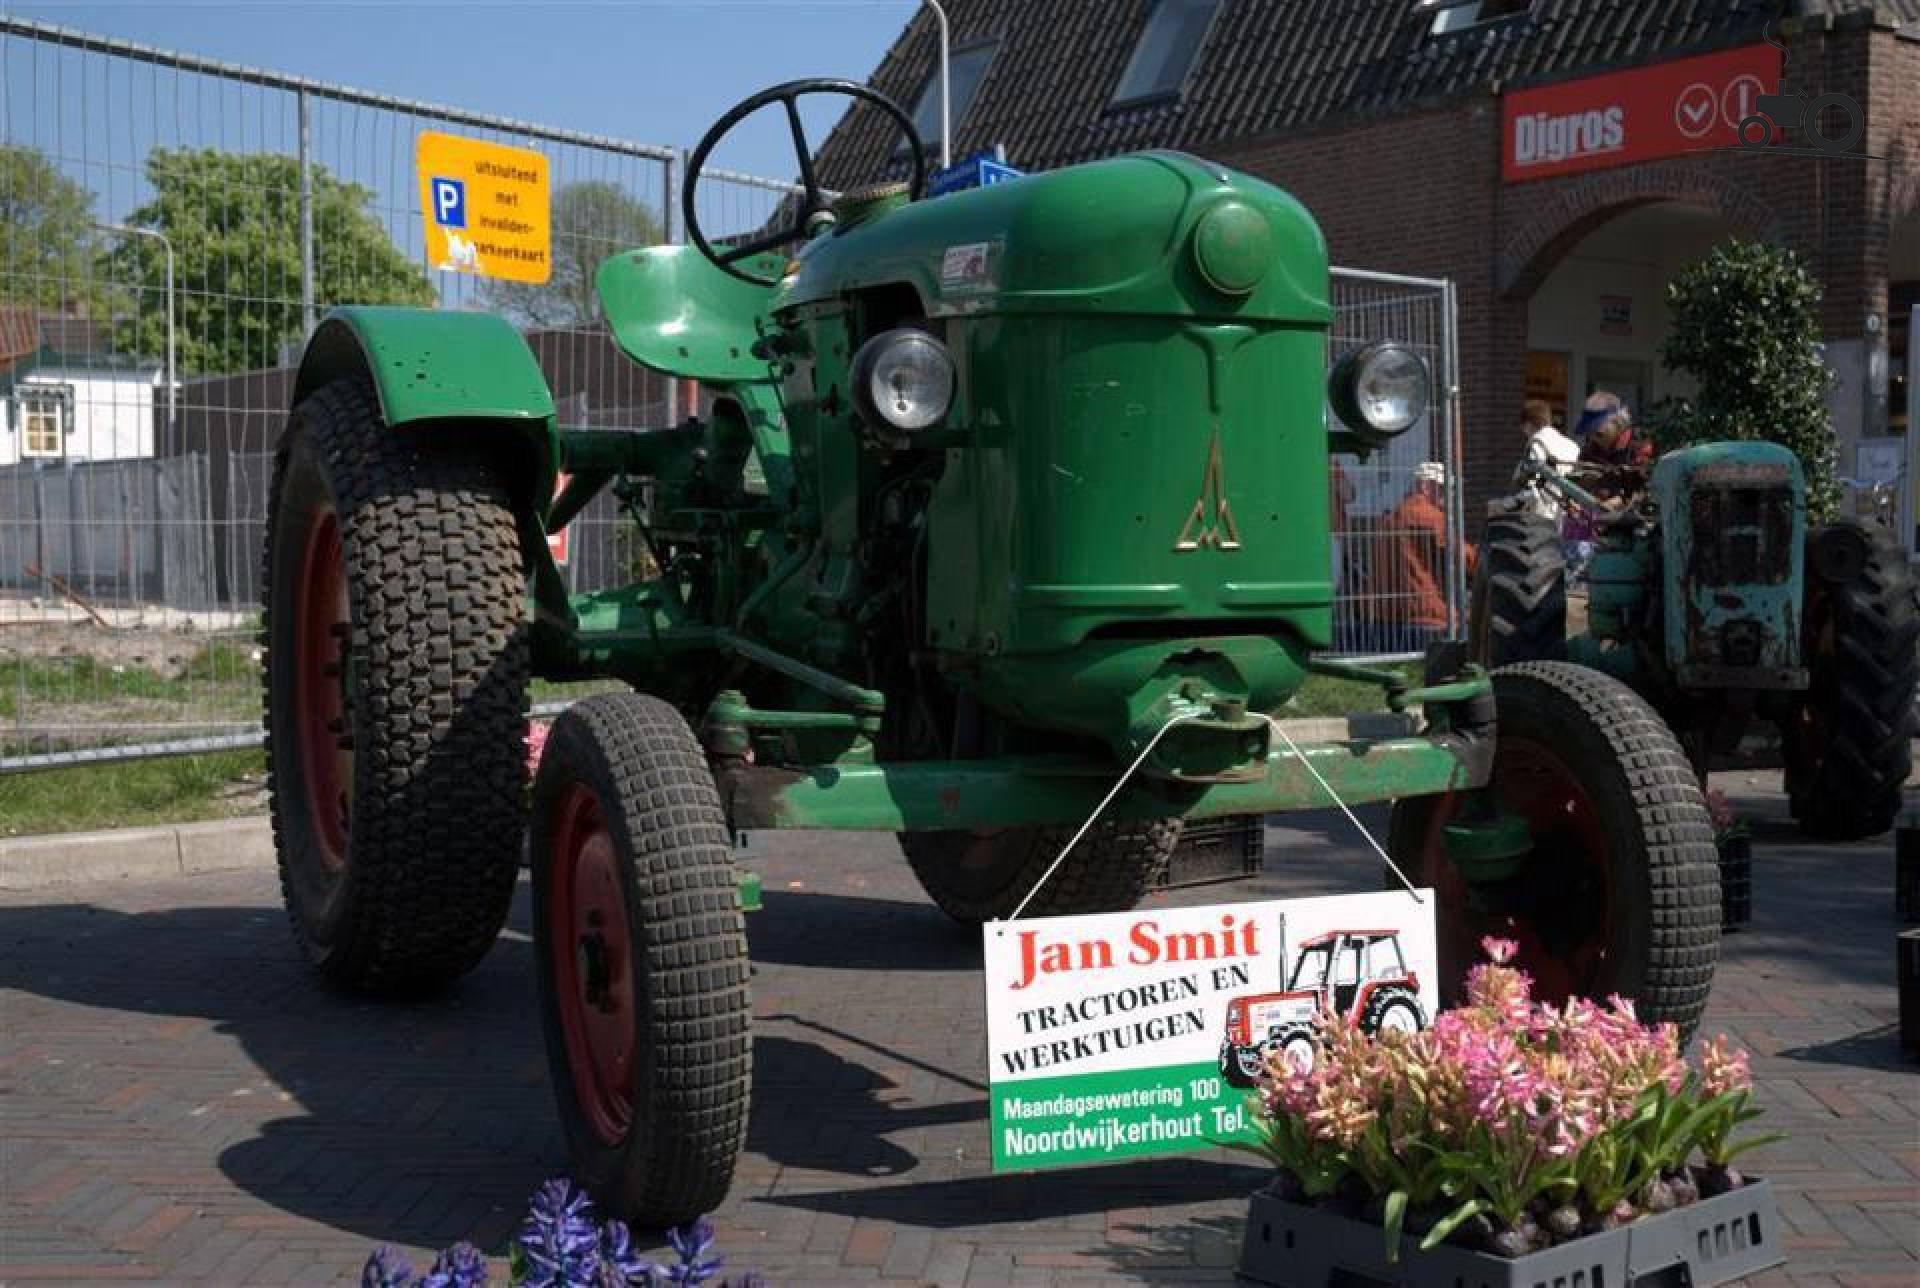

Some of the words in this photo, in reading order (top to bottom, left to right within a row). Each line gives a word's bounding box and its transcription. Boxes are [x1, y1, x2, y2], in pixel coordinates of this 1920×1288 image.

[1516, 107, 1623, 164] Digros
[475, 162, 537, 183] uitsluitend
[495, 191, 518, 207] met
[438, 183, 459, 221] P
[1009, 928, 1115, 990] Jan
[1127, 913, 1261, 966] Smit
[1017, 973, 1199, 1035] TRACTOREN
[1210, 962, 1251, 991] EN
[1000, 1008, 1205, 1074] WERKTUIGEN
[1003, 1083, 1183, 1120] Maandagsewetering
[1189, 1077, 1221, 1102] 100
[1004, 1111, 1203, 1157] Noordwijkerhout
[1211, 1103, 1249, 1134] Tel.
